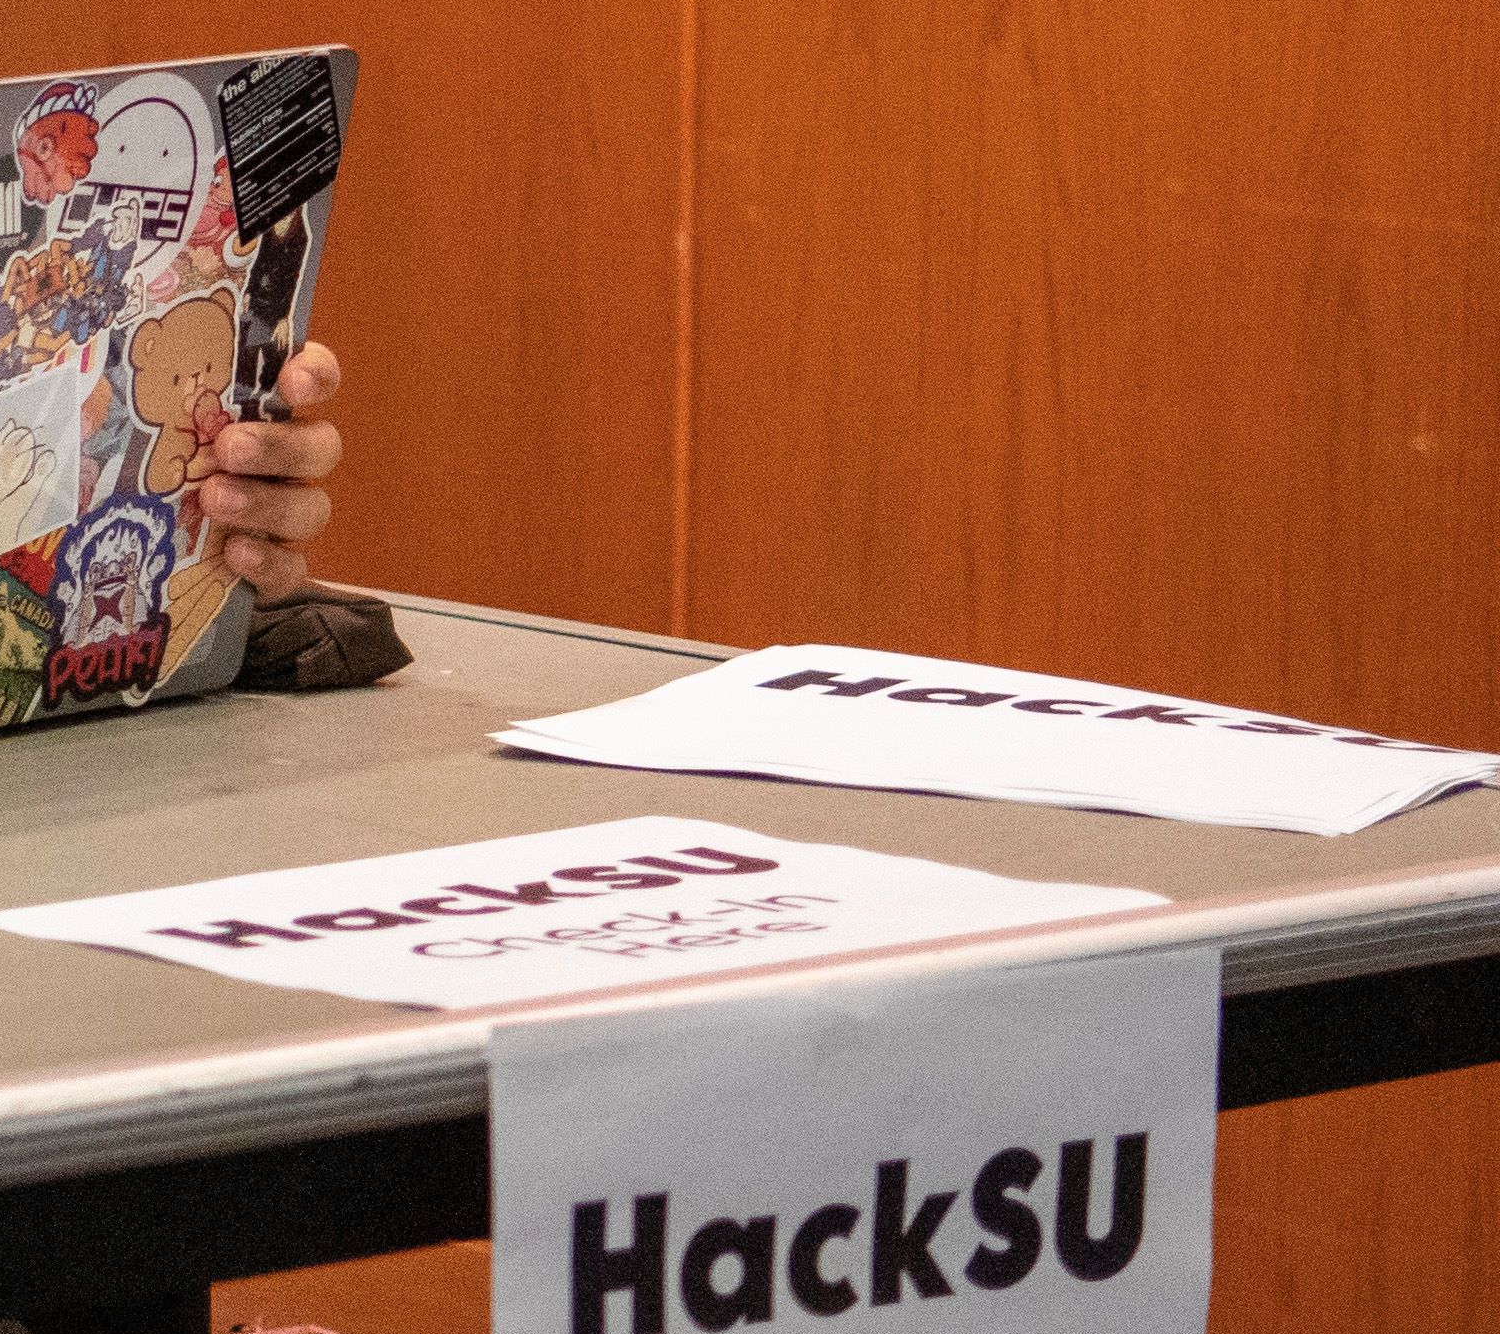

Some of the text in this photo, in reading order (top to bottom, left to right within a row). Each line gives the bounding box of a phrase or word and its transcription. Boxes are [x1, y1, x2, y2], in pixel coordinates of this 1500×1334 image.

[222, 57, 285, 102] the albu
[146, 845, 782, 952] HackSU
[411, 894, 840, 959] Check-In
[578, 921, 828, 958] Here
